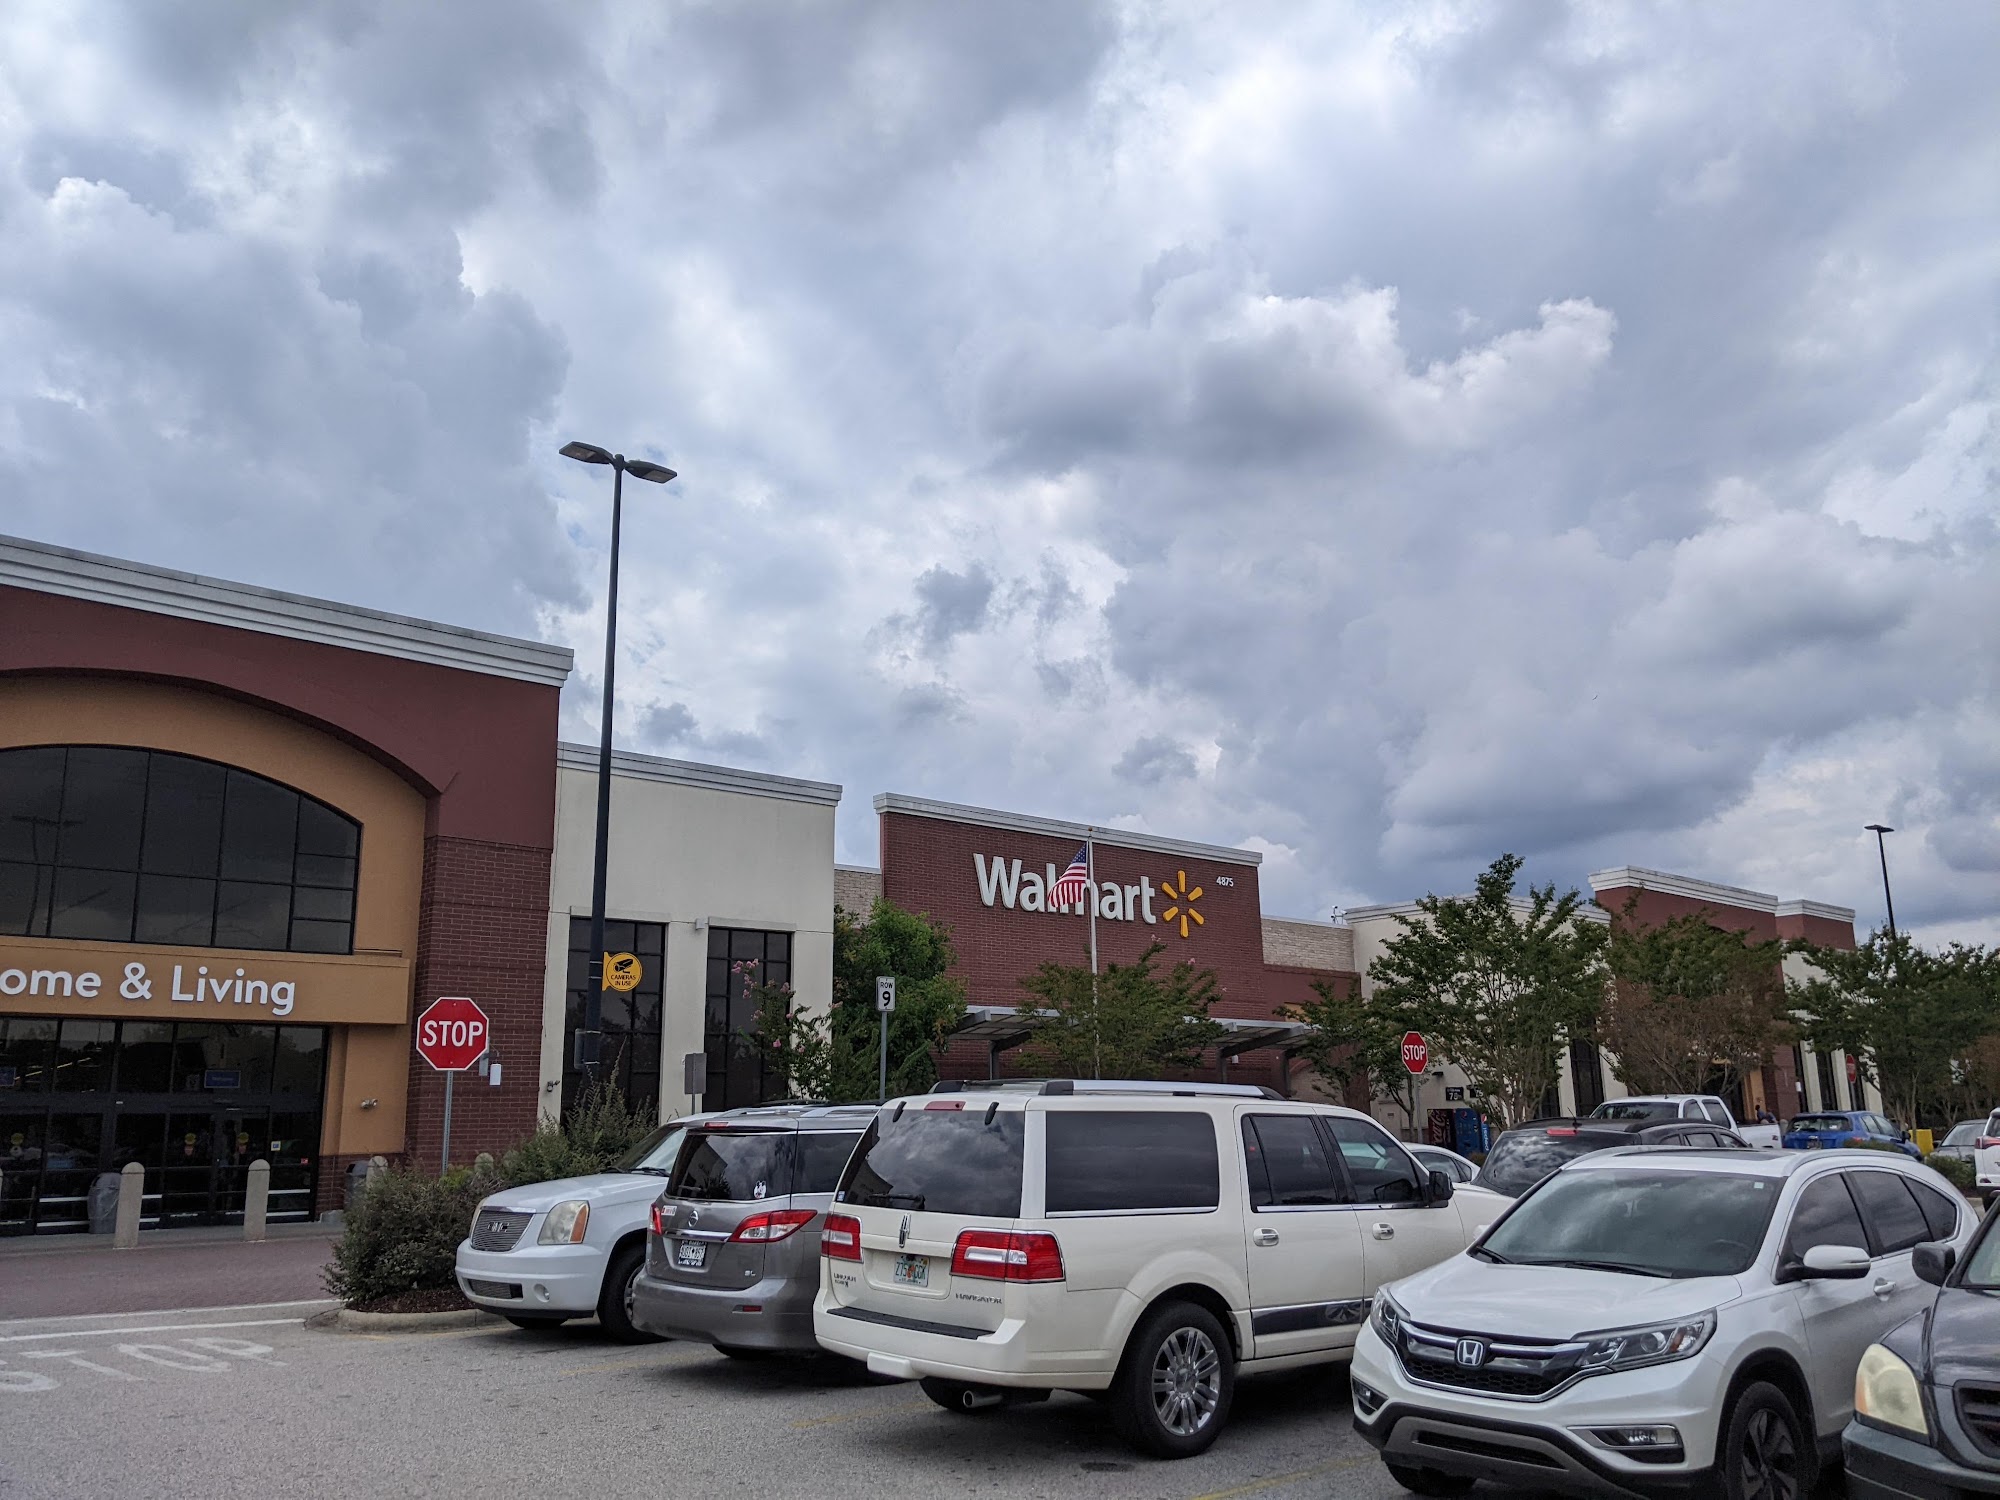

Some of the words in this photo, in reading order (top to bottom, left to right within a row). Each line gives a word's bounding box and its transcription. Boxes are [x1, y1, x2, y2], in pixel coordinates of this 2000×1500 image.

[1216, 876, 1234, 887] 4875
[119, 962, 152, 1000] &
[171, 965, 296, 1016] Living
[880, 981, 893, 989] ROW
[882, 990, 891, 1007] 9
[422, 1020, 483, 1047] STOP
[1403, 1044, 1426, 1061] STOP
